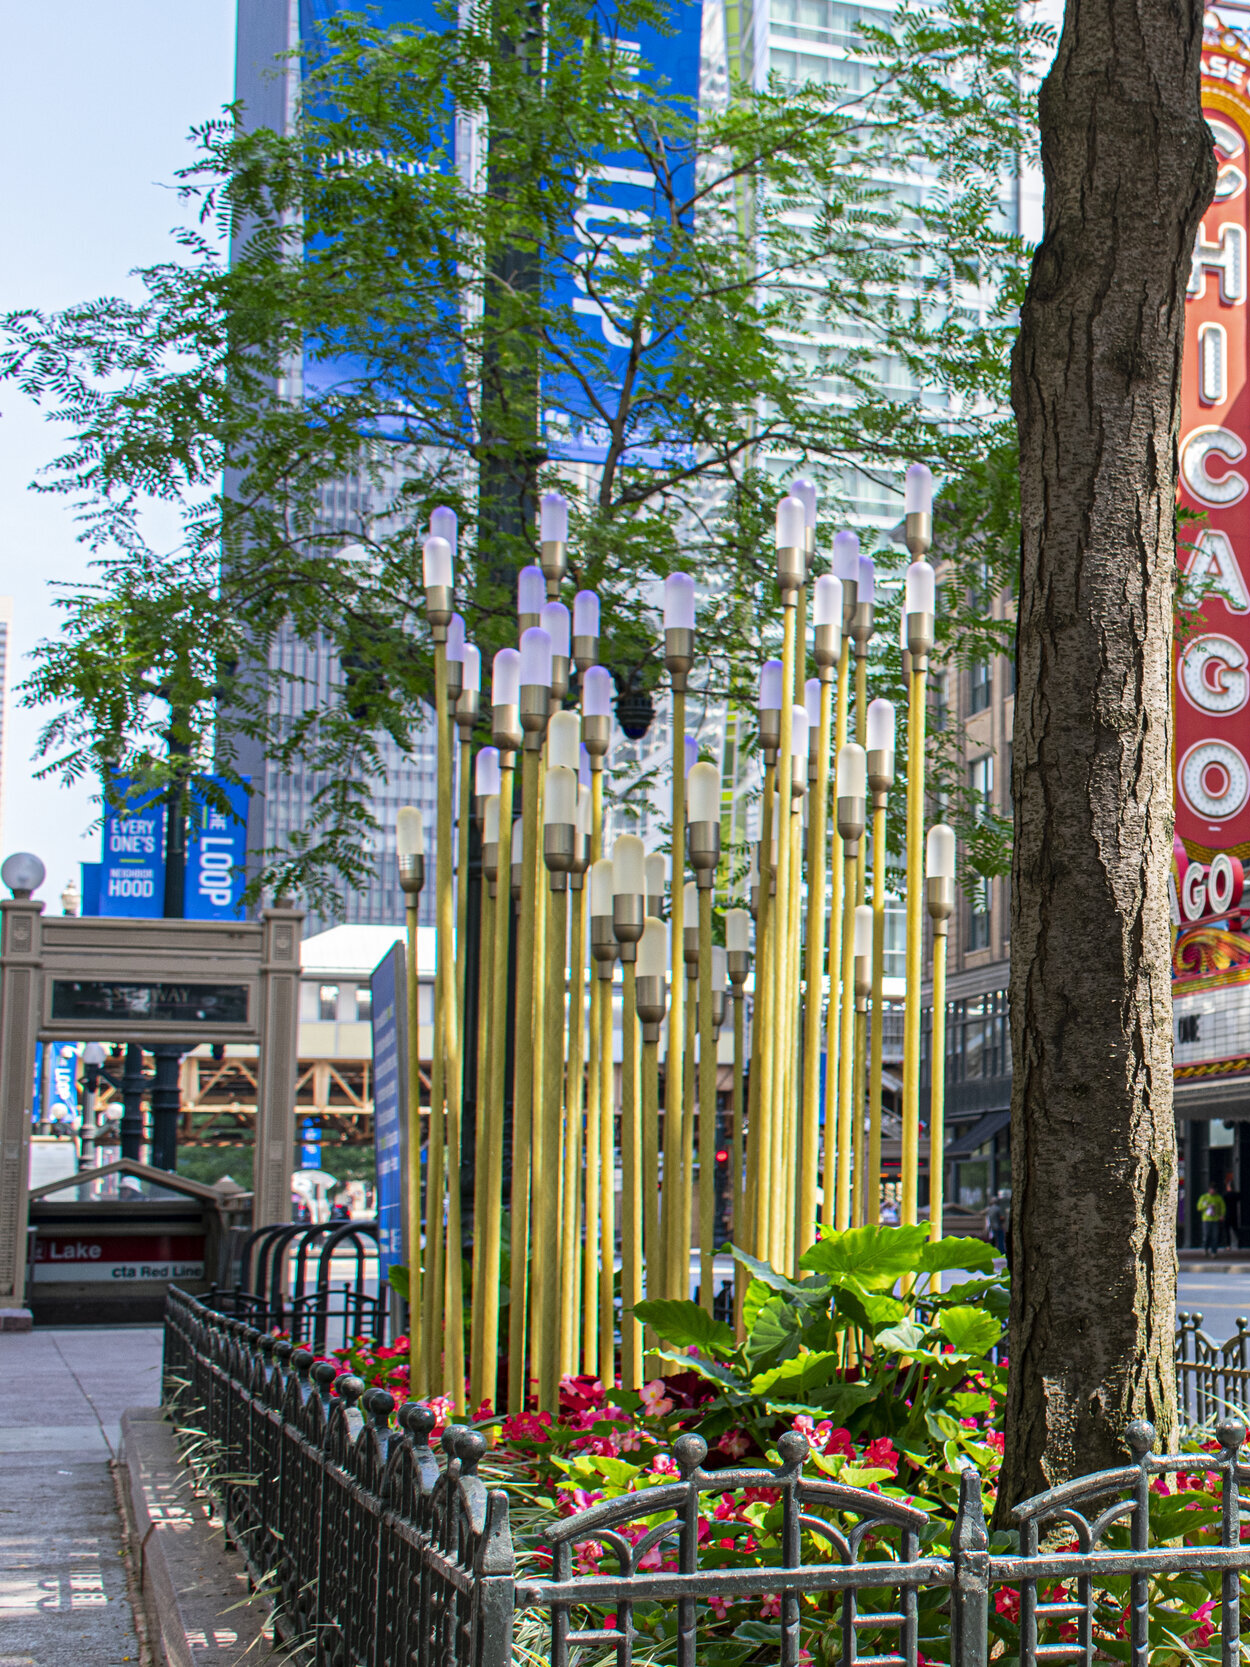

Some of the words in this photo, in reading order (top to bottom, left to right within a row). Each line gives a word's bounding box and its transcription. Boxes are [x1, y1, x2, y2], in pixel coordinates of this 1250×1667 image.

[111, 819, 156, 835] EVERY
[110, 835, 156, 853] ONE'S
[199, 836, 235, 906] LOOP
[108, 879, 154, 897] HOOD
[51, 1242, 102, 1259] Lake
[112, 1266, 136, 1278] cta
[141, 1266, 169, 1277] Red
